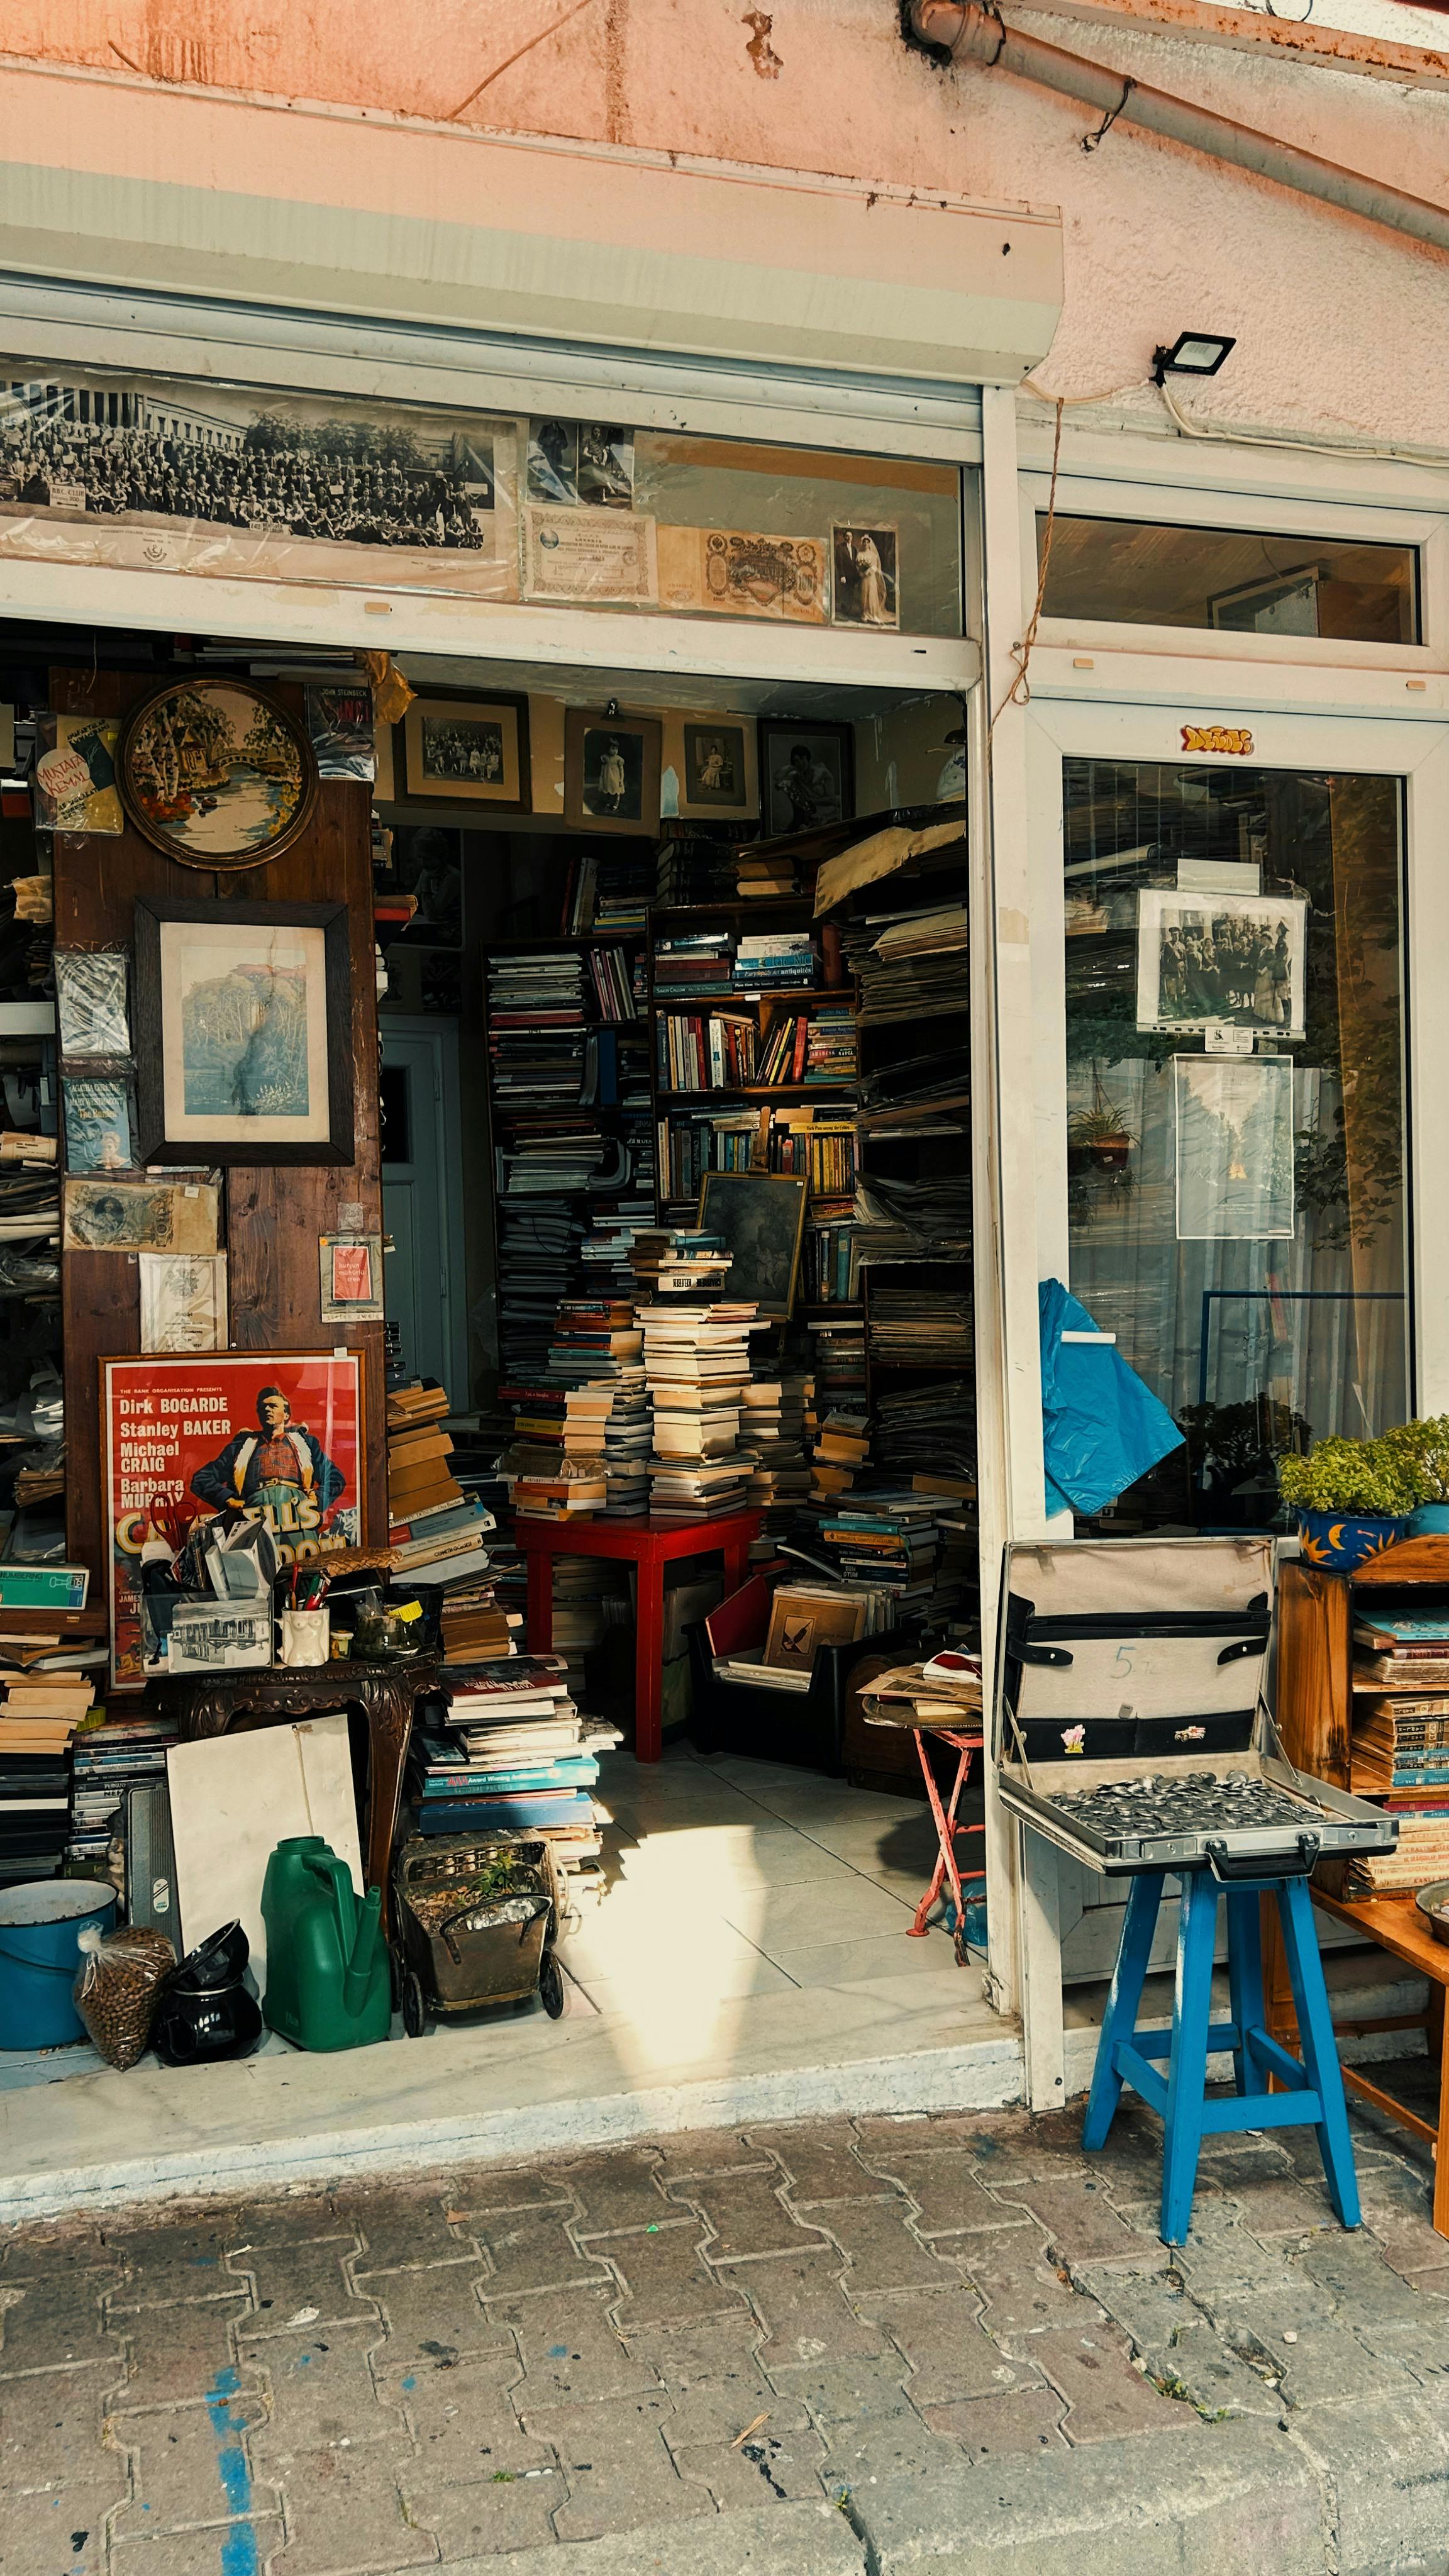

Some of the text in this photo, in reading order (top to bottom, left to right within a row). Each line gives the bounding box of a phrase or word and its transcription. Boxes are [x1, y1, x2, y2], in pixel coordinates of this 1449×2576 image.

[337, 689, 367, 697] STEINBECK
[37, 754, 86, 782] MUSTAFA
[45, 771, 91, 797] KEMAL
[119, 1397, 228, 1414] Dirk BOGARDE
[120, 1419, 231, 1439] Stanley BAKER
[120, 1441, 180, 1458] Michael
[121, 1457, 165, 1474] CRAIG
[121, 1478, 185, 1493] Barbara
[487, 1775, 510, 1783] Winning
